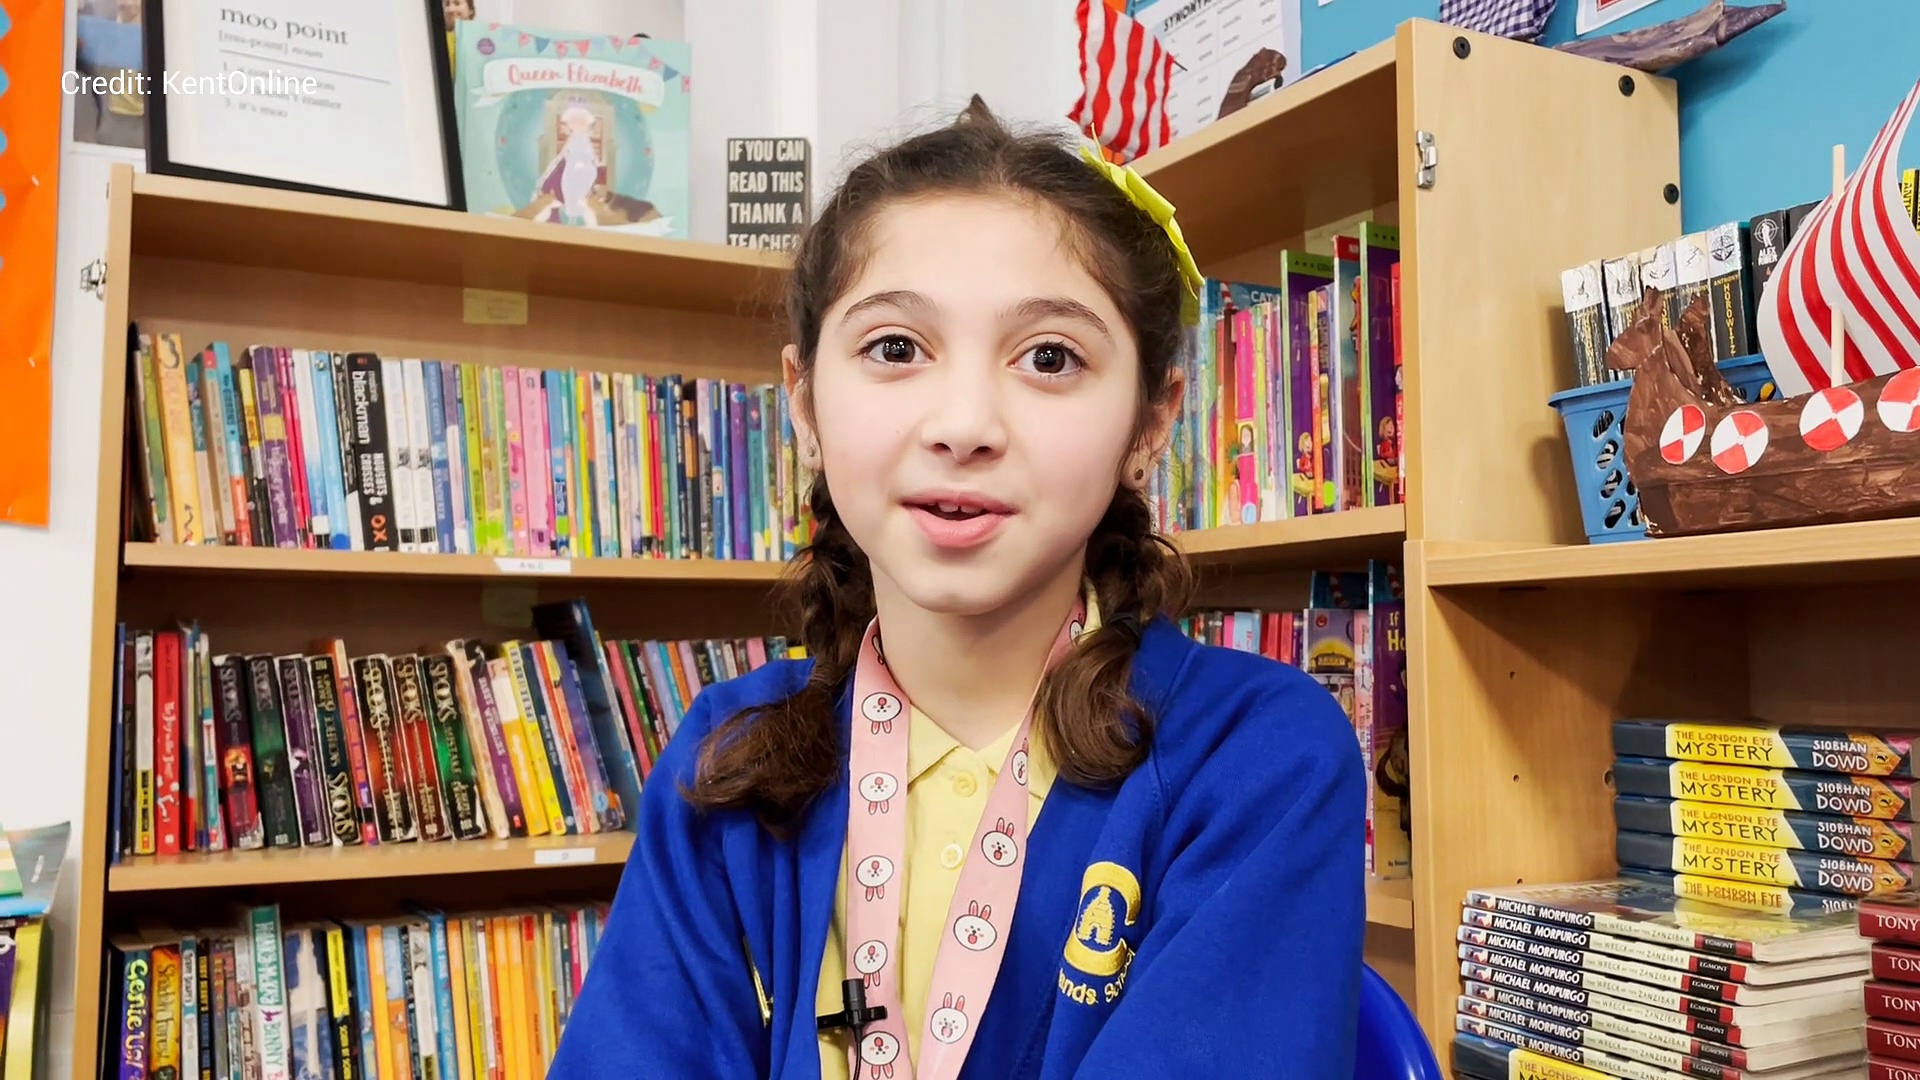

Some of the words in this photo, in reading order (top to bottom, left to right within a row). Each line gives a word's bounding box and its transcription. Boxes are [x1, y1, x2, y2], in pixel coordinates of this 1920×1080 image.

[221, 8, 277, 31] moo
[286, 21, 348, 45] point
[508, 64, 562, 85] Queen
[568, 63, 643, 94] Elizabeth
[729, 140, 744, 161] IF
[745, 140, 774, 161] YOU
[776, 140, 804, 161] CAN
[729, 171, 768, 193] READ
[771, 171, 804, 193] THIS
[729, 202, 786, 224] THANK
[792, 202, 802, 224] A
[1723, 282, 1736, 355] HOROWITZ
[352, 370, 371, 445] blackman
[1676, 730, 1696, 740] THE
[1699, 732, 1747, 744] LONDON
[1752, 736, 1773, 746] EYE
[1813, 739, 1867, 753] SIOBHAN
[1676, 741, 1773, 762] MYSTERY
[1812, 752, 1868, 771] DOWD
[1680, 770, 1699, 780] THE
[1702, 772, 1751, 785] LONDON
[1756, 777, 1777, 788] EYE
[1681, 782, 1777, 803] MYSTERY
[1816, 782, 1870, 796] SIOBHAN
[1816, 794, 1872, 814] DOWD
[1680, 808, 1700, 819] THE
[1703, 810, 1752, 823] LONDON
[1758, 815, 1778, 826] EYE
[1682, 820, 1778, 842] MYSTERY
[1818, 822, 1872, 836] SIOBHAN
[1817, 833, 1873, 853] DOWD
[1682, 842, 1702, 853] THE
[1706, 845, 1754, 859] LONDON
[1760, 852, 1780, 863] EYE
[1683, 854, 1780, 878] MYSTERY
[1820, 859, 1873, 873] SIOBHAN
[1818, 870, 1874, 892] DOWD
[1499, 900, 1536, 916] MICHAEL
[1539, 908, 1591, 926] MORPURGO
[1494, 917, 1531, 934] MICHAEL
[1535, 926, 1586, 945] MORPURGO
[1875, 914, 1919, 932] TONY
[1652, 929, 1690, 942] ZANZIBAR
[1705, 939, 1733, 949] EGMONT
[1488, 935, 1525, 952] MICHAEL
[1528, 944, 1579, 963] MORPURGO
[1646, 950, 1684, 964] ZANZIBAR
[1490, 953, 1527, 970] MICHAEL
[1529, 962, 1579, 983] MORPURGO
[1699, 962, 1727, 972] EGMONT
[1888, 956, 1920, 972] TON
[1639, 967, 1677, 983] ZANZIBAR
[126, 959, 149, 1030] Genie
[1493, 972, 1530, 990] MICHAEL
[1534, 982, 1585, 1003] MORPURGO
[1692, 980, 1719, 991] EGMONT
[1638, 991, 1676, 1005] ZANZIBAR
[1497, 992, 1534, 1010] MICHAEL
[1537, 1002, 1588, 1023] MORPURGO
[1690, 1002, 1717, 1014] EGMONT
[1489, 1008, 1526, 1026] MICHAEL
[1529, 1017, 1580, 1040] MORPURGO
[1645, 1010, 1682, 1024] ZANZIBAR
[1697, 1023, 1724, 1035] EGMONT
[1488, 1027, 1525, 1045] MICHAEL
[1529, 1037, 1580, 1061] MORPURGO
[1649, 1032, 1686, 1048] ZANZIBAR
[1640, 1049, 1678, 1065] ZANZIBAR
[1701, 1045, 1729, 1058] EGMONT
[1518, 1060, 1537, 1072] THE
[1692, 1063, 1720, 1075] EGMONT
[1886, 1068, 1920, 1080] TON
